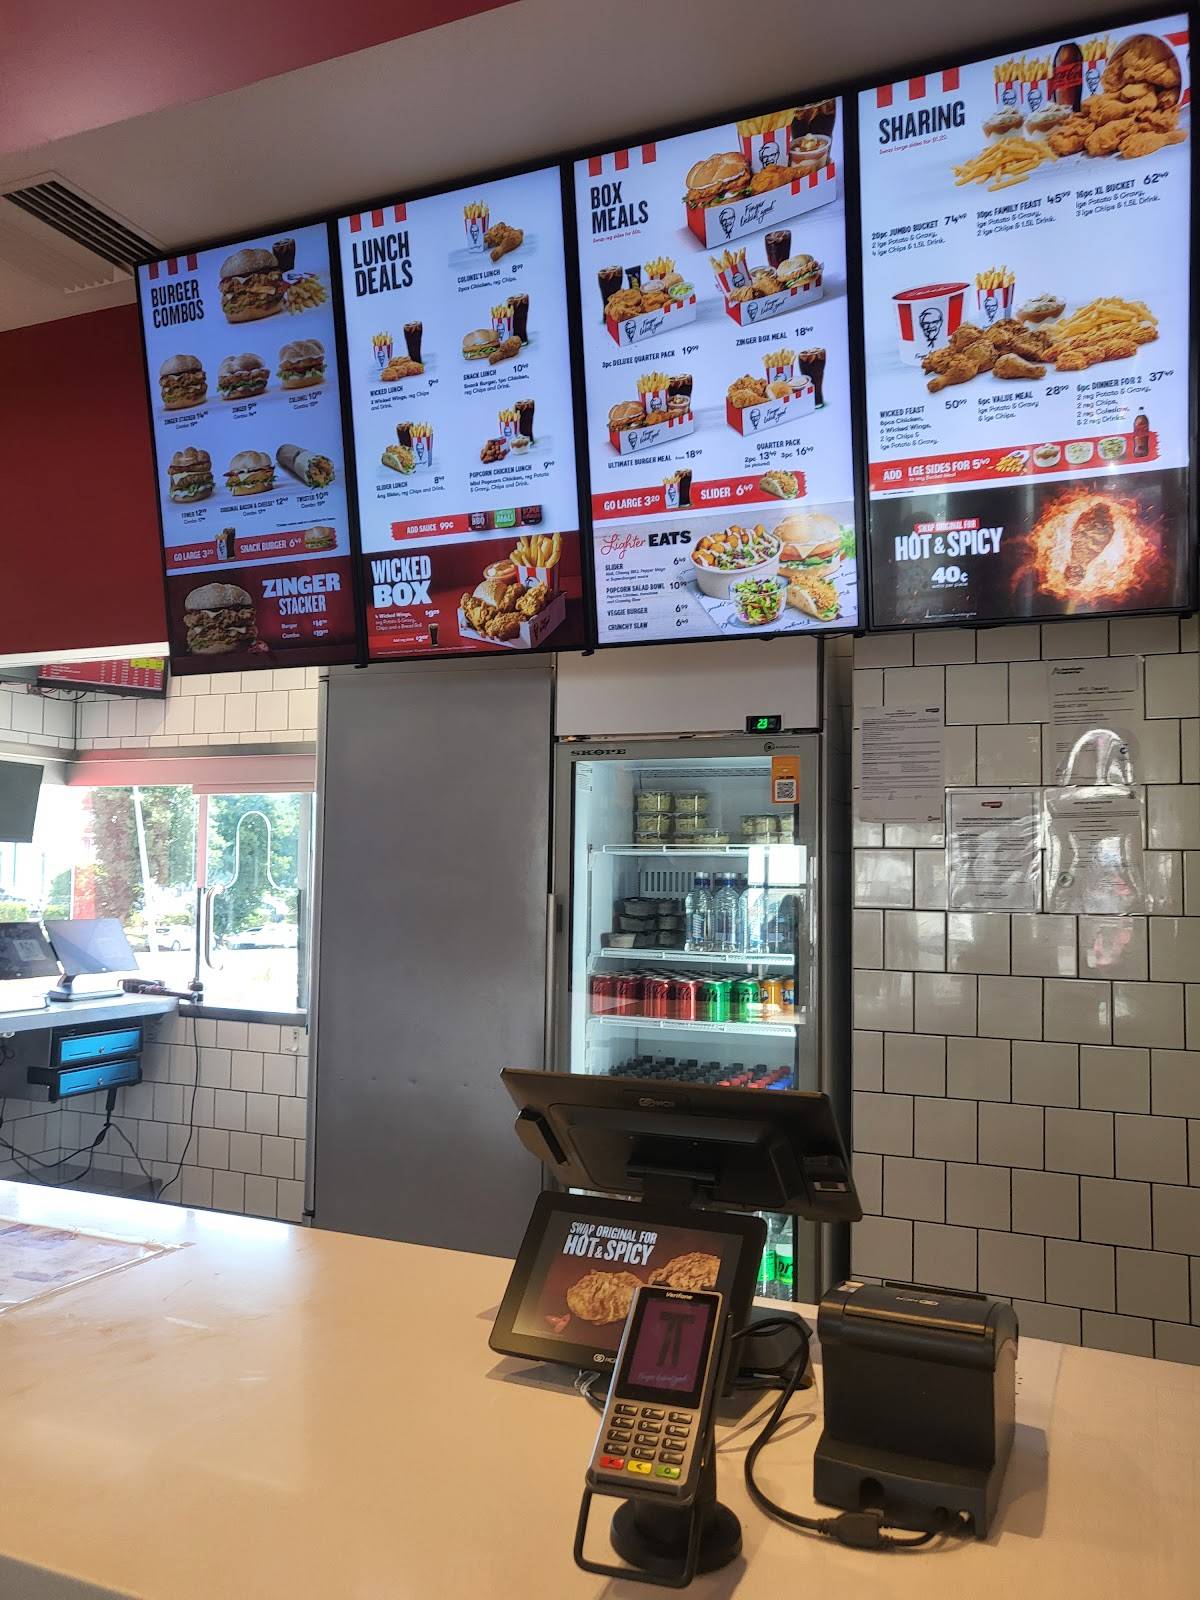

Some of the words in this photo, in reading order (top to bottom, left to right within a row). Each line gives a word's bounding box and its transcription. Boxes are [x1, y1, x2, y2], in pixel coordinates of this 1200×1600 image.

[878, 99, 965, 145] SHARING
[1094, 186, 1103, 195] XL
[1105, 179, 1135, 192] BUCKET
[590, 180, 622, 209] BOX
[1088, 195, 1111, 205] Potato
[745, 199, 765, 216] Finger
[994, 203, 1018, 215] FAMILY
[1020, 198, 1042, 210] FEAST
[1094, 203, 1114, 213] Chips
[591, 199, 648, 234] MEALS
[988, 215, 1010, 225] Potato
[889, 225, 911, 236] JUMBO
[913, 220, 938, 231] BUCKET
[994, 223, 1013, 233] Chips
[888, 235, 908, 245] Potato
[352, 230, 409, 268] LUNCH
[888, 244, 906, 254] Chips
[354, 258, 413, 297] DEALS
[483, 268, 500, 278] LUNCH
[150, 278, 199, 307] BURGER
[152, 299, 204, 329] COMBOS
[735, 336, 756, 346] ZINGER
[758, 334, 769, 342] BOX
[771, 331, 787, 340] MEAL
[612, 356, 632, 366] DELUXE
[634, 352, 659, 363] QUARTER
[660, 349, 674, 358] PACK
[463, 372, 478, 380] SNACK
[480, 369, 496, 377] LUNCH
[1091, 379, 1118, 389] DINNER
[1120, 377, 1134, 385] FOR
[1137, 375, 1141, 383] 2
[370, 388, 387, 396] WICKED
[387, 385, 403, 393] LUNCH
[992, 393, 1013, 403] VALUE
[1014, 390, 1032, 400] MEAL
[1095, 389, 1118, 398] Potato
[880, 408, 903, 418] WICKED
[905, 405, 924, 414] FEAST
[988, 403, 1010, 411] Potato
[896, 432, 913, 440] Chips
[756, 440, 783, 450] QUARTER
[785, 438, 800, 446] PACK
[607, 459, 633, 469] ULTIMATE
[634, 456, 655, 465] BURGER
[657, 454, 671, 462] MEAL
[744, 455, 755, 463] 2pc
[469, 470, 491, 478] POPCORN
[493, 466, 514, 475] CHICKEN
[882, 469, 902, 481] ADD
[908, 465, 924, 476] LGE
[925, 462, 951, 474] SIDES
[952, 460, 970, 471] FOR
[700, 486, 730, 500] SLIDER
[603, 499, 615, 511] GO
[616, 496, 642, 509] LARGE
[418, 523, 436, 532] SAUCE
[963, 519, 976, 528] FOR
[239, 543, 260, 553] SNACK
[261, 540, 286, 551] BURGER
[600, 530, 645, 560] Lighter
[648, 529, 691, 547] EATS
[894, 531, 932, 561] HOT
[933, 536, 946, 554] &
[946, 526, 1004, 557] SPICY
[173, 552, 182, 561] GO
[182, 550, 201, 560] LARGE
[371, 555, 432, 584] WICKED
[261, 572, 341, 598] ZINGER
[606, 585, 630, 593] POPCORN
[372, 579, 432, 608] BOX
[278, 594, 326, 615] STACKER
[571, 748, 626, 756] SKOPE
[570, 1222, 595, 1235] SWAP
[596, 1225, 637, 1242] ORIGINAL
[638, 1231, 658, 1244] FOR
[563, 1234, 599, 1258] HOT
[594, 1245, 603, 1259] &
[603, 1239, 655, 1266] SPICY
[665, 1291, 694, 1300] Verifone
